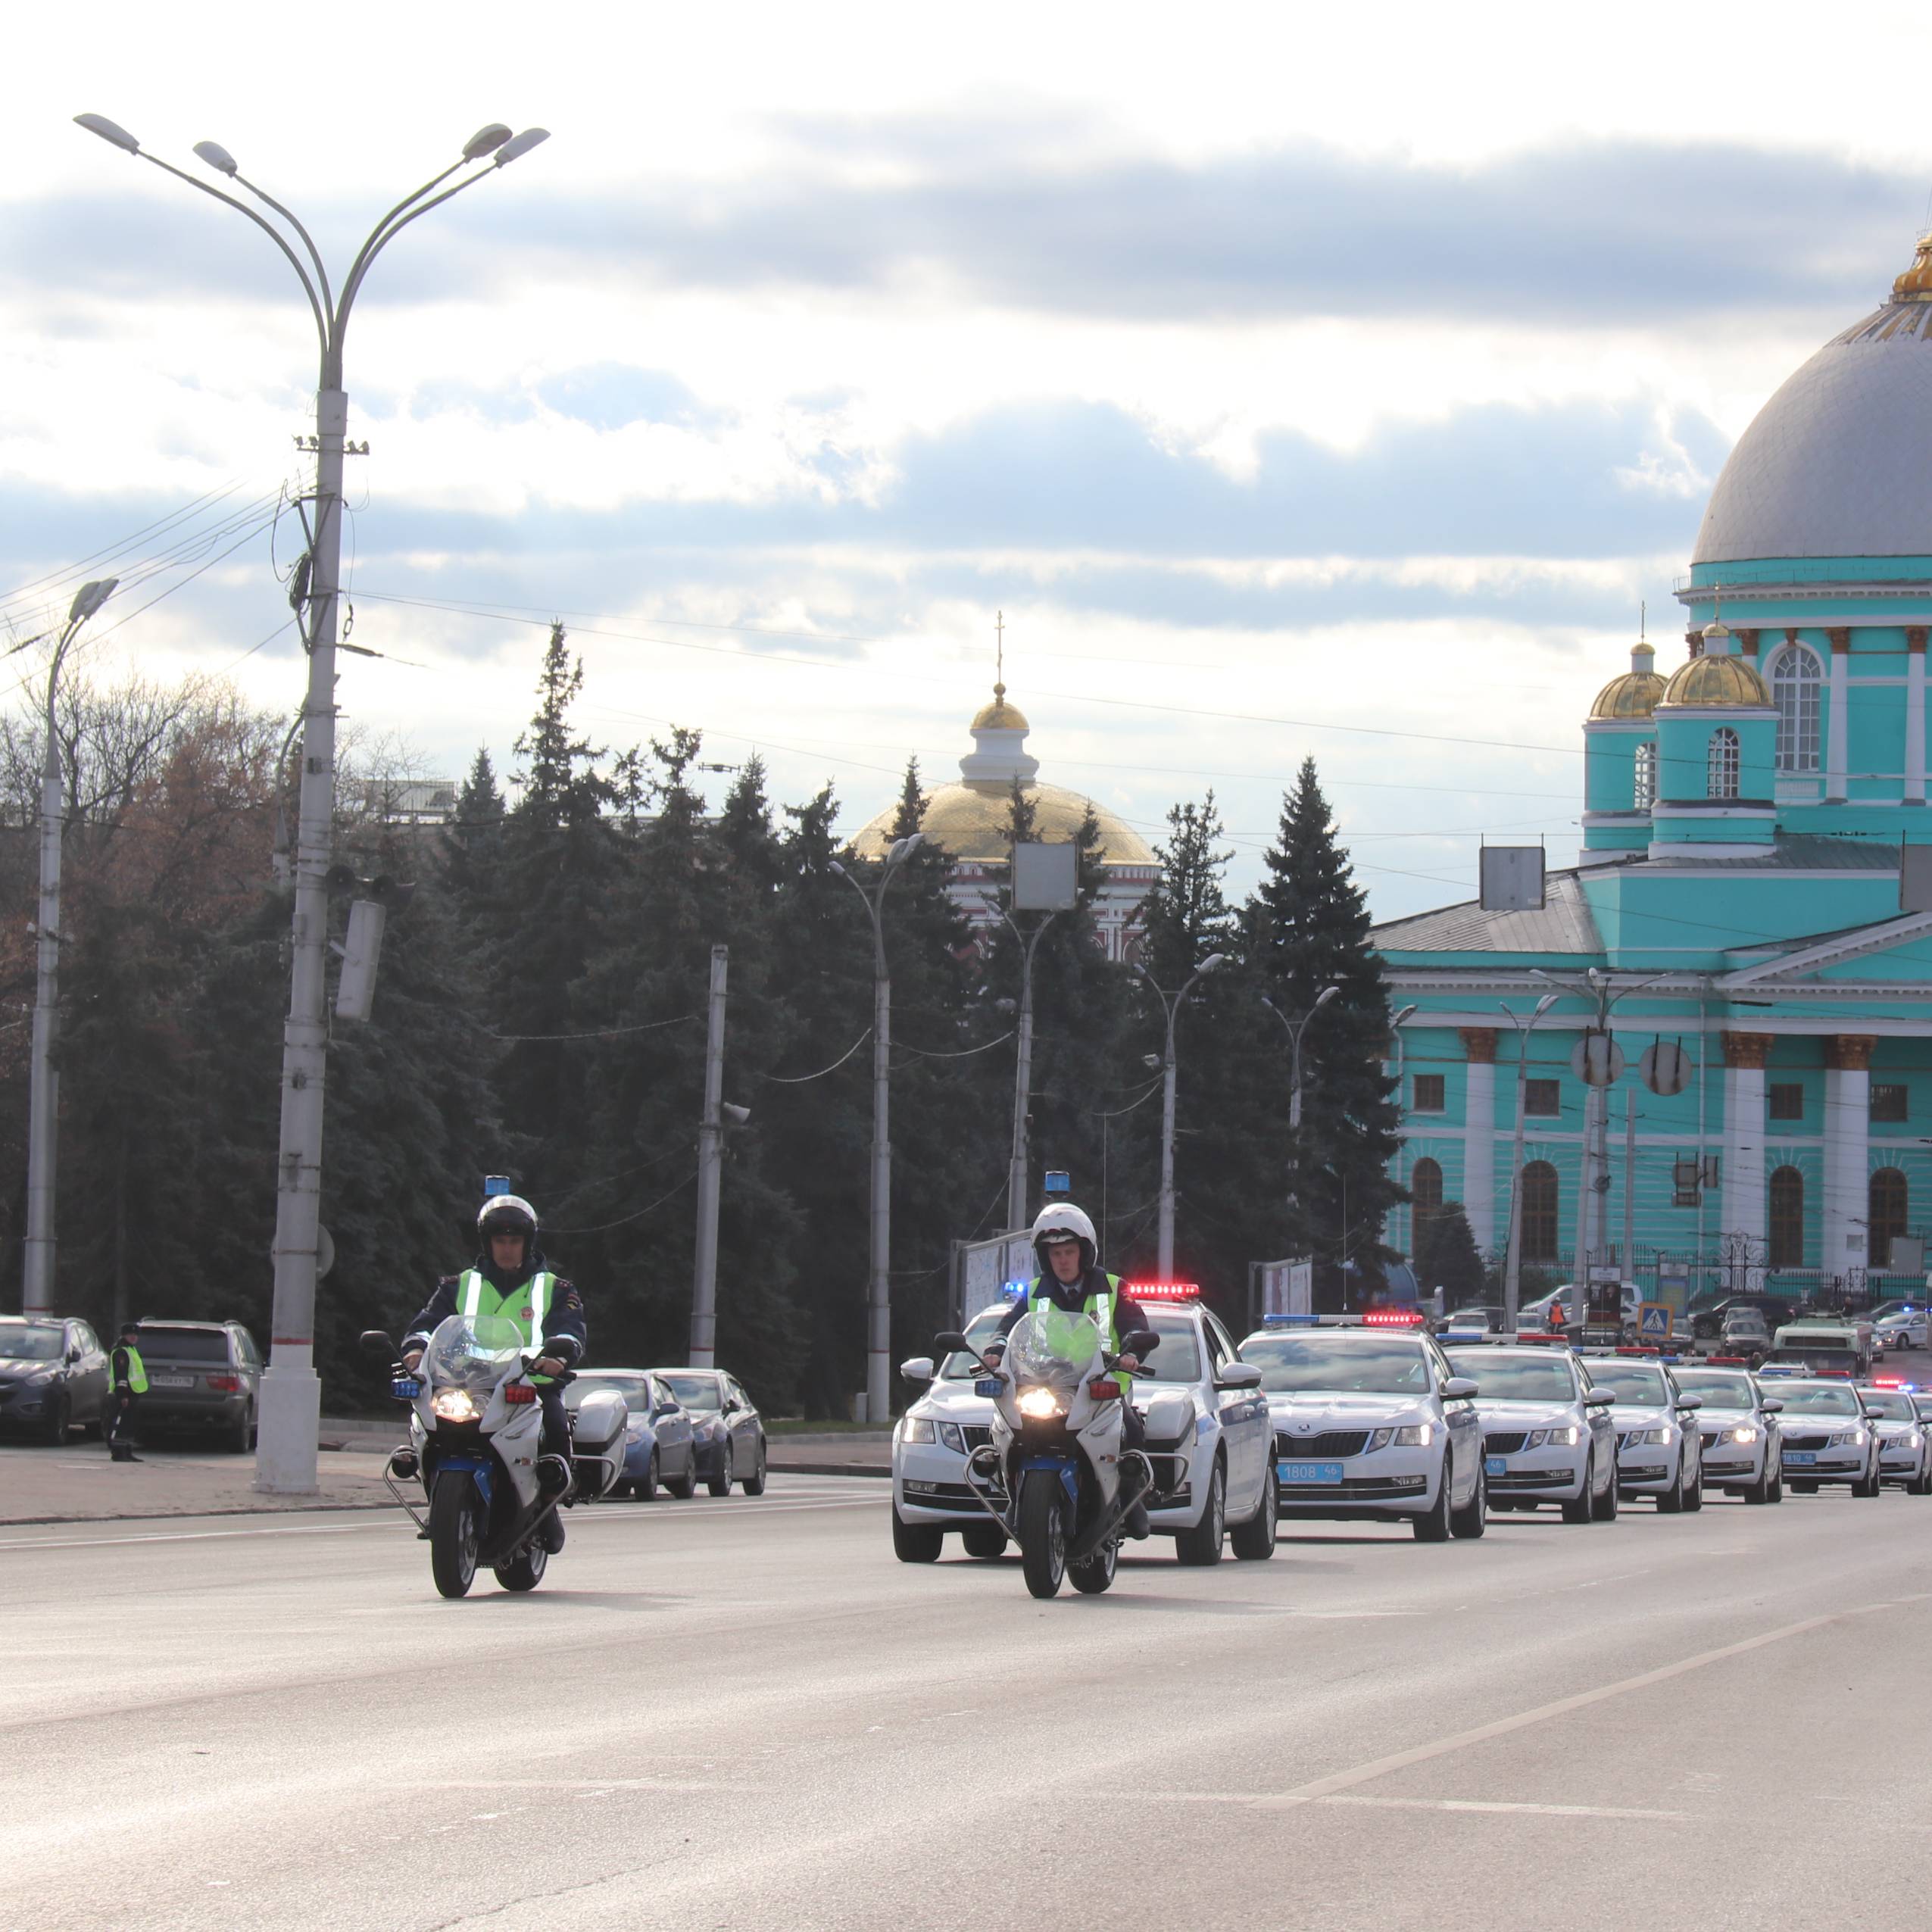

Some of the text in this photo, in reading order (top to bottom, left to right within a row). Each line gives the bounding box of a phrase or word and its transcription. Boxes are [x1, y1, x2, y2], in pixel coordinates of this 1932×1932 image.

[1490, 1459, 1502, 1469] 46
[1284, 1465, 1337, 1479] 1808 46
